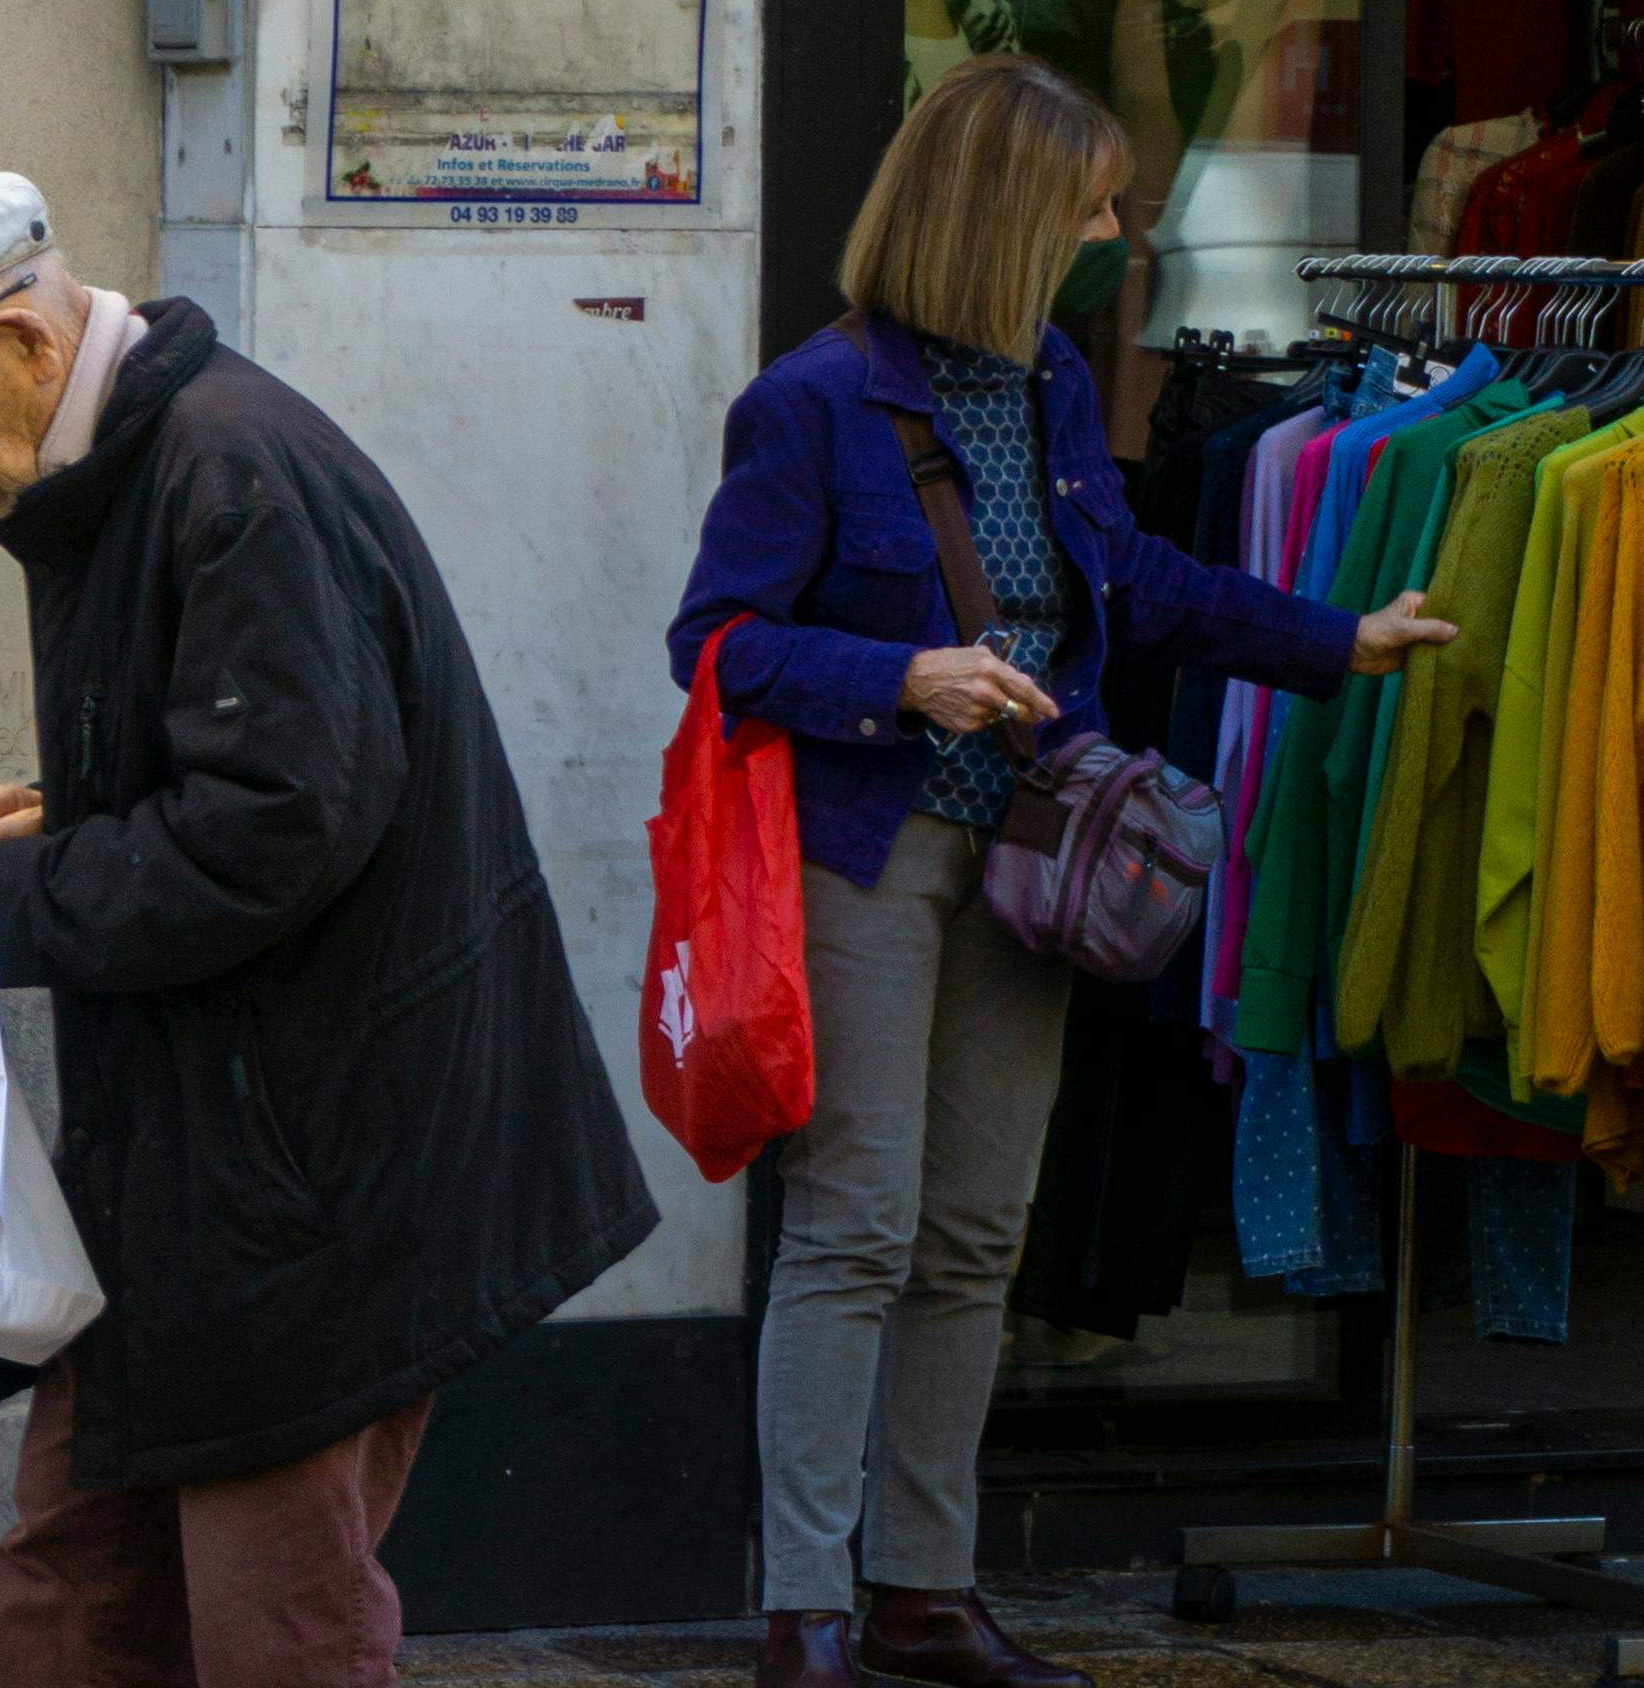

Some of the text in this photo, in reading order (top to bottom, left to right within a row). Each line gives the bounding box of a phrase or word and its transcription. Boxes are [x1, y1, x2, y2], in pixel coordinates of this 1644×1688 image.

[437, 158, 591, 172] Infos et Réservations
[450, 206, 472, 223] 04
[477, 206, 499, 223] 93
[505, 207, 525, 223] 19
[530, 207, 552, 223] 39
